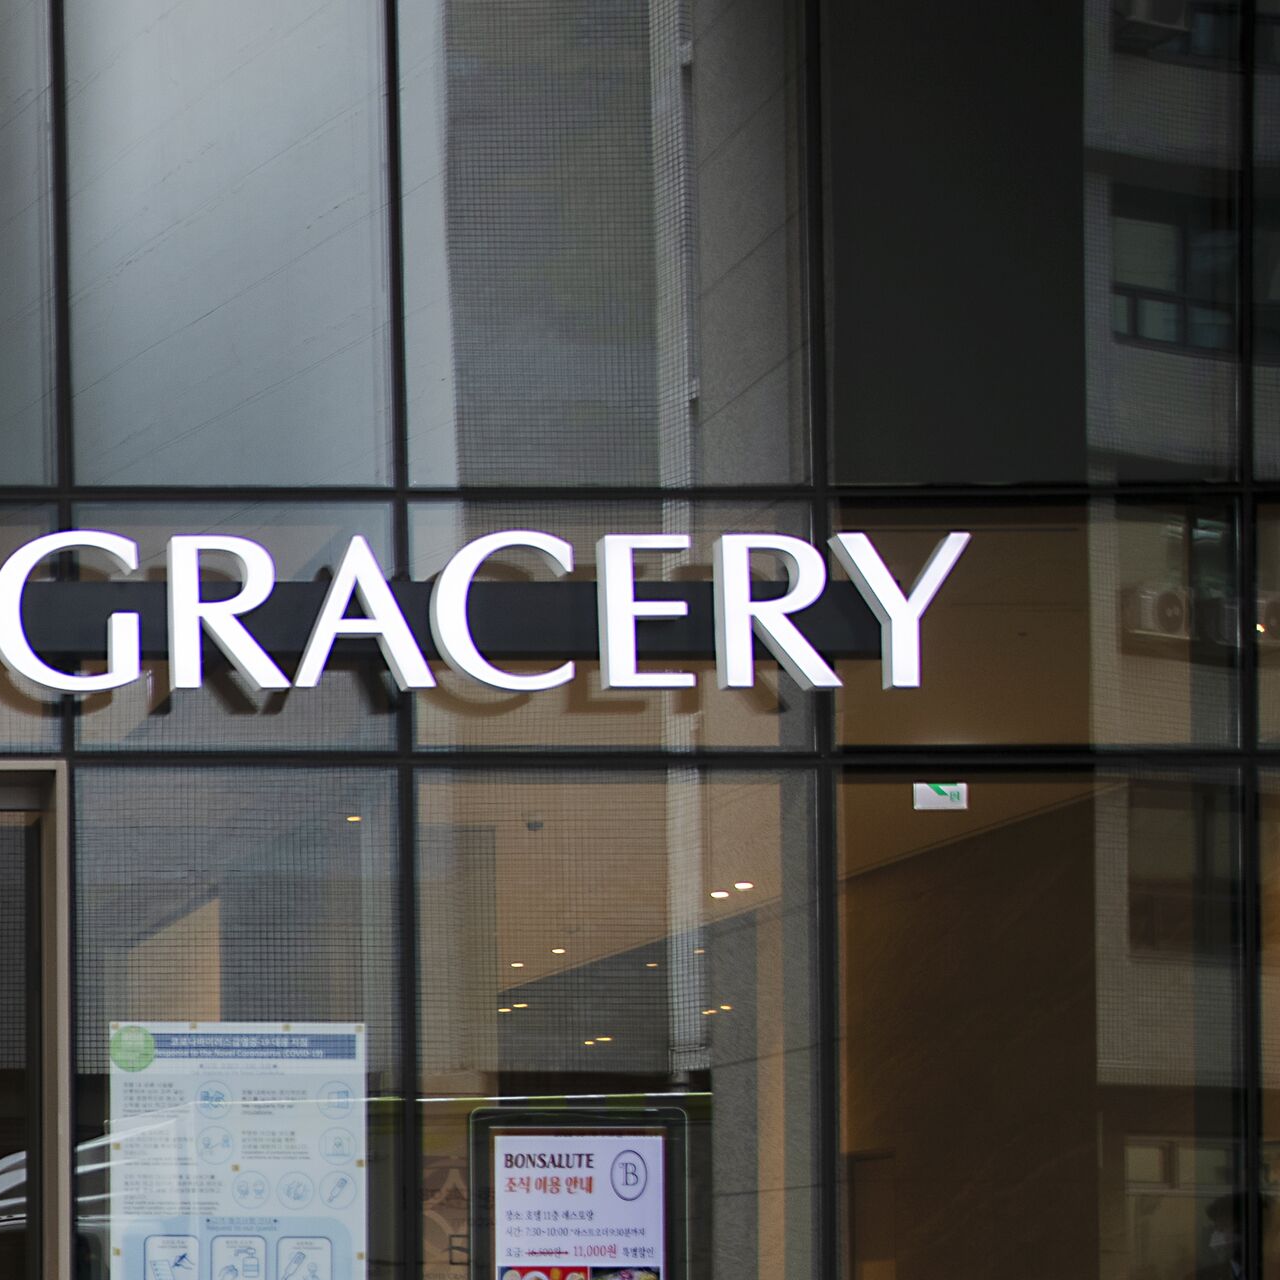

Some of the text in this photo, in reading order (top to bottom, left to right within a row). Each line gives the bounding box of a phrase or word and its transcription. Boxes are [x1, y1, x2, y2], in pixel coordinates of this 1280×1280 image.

[504, 1153, 595, 1169] BONSALUTE
[504, 1176, 594, 1194] 조식 이용 안내
[572, 1243, 617, 1259] 11,000원
